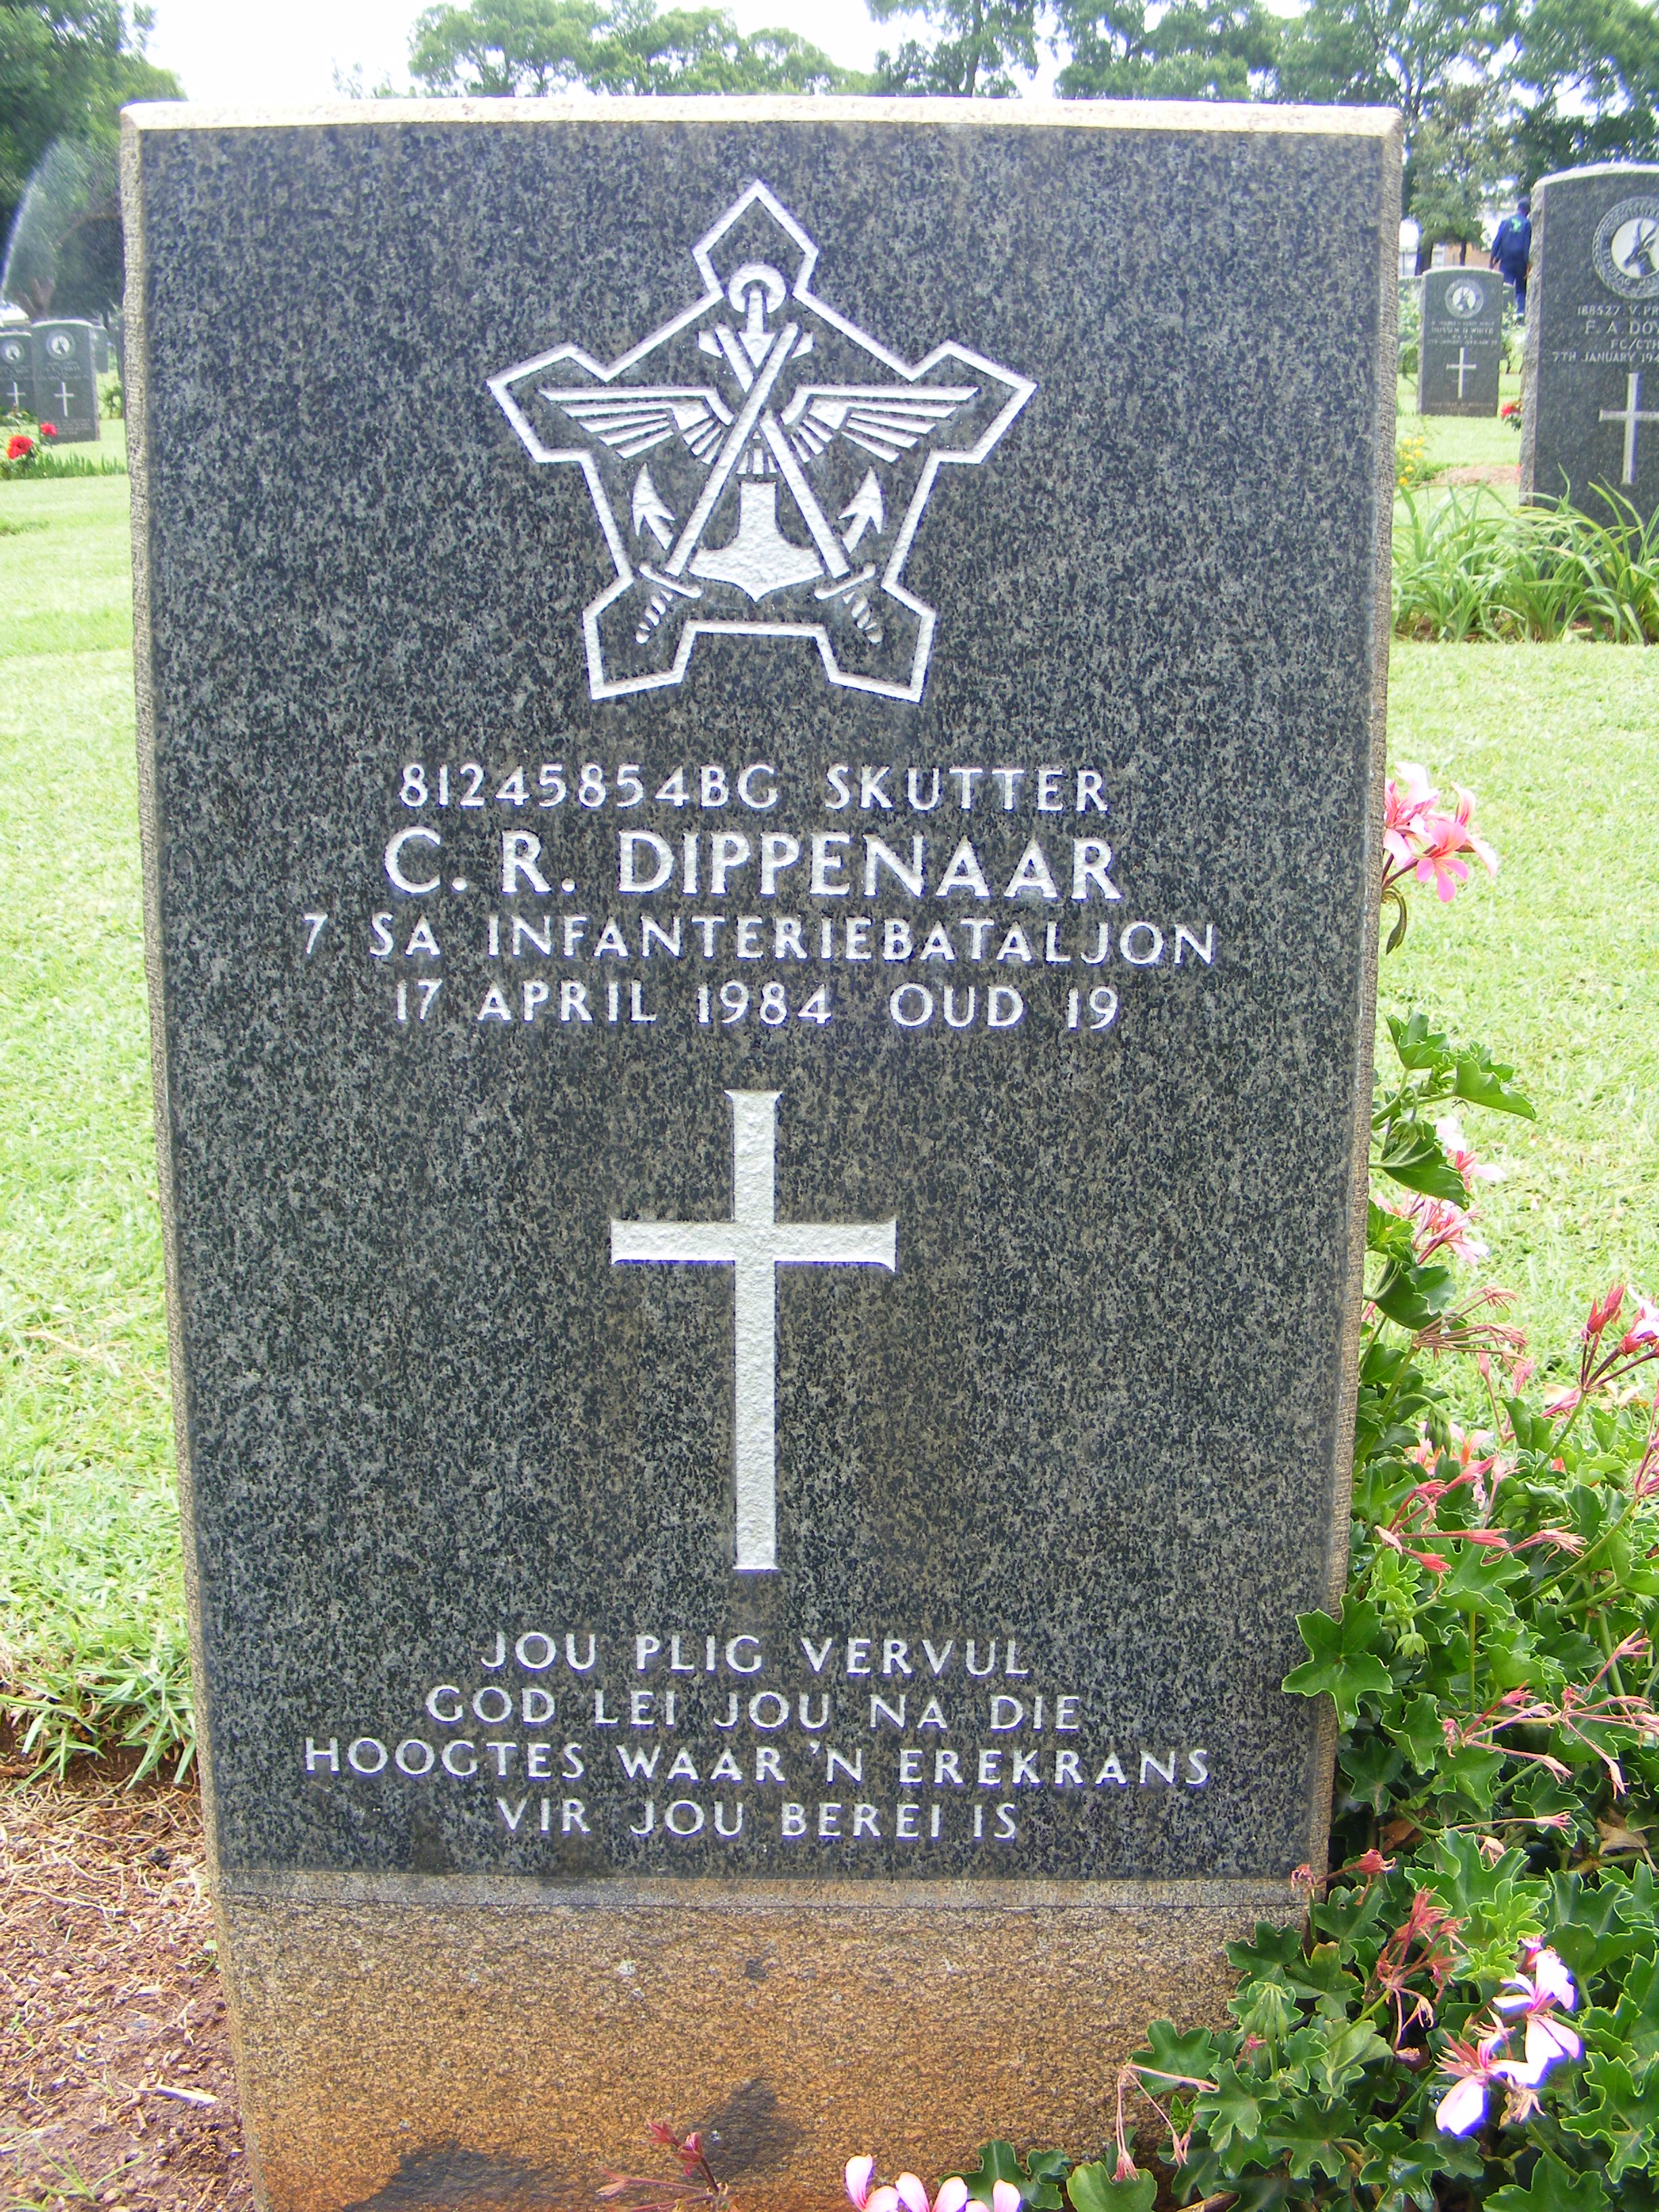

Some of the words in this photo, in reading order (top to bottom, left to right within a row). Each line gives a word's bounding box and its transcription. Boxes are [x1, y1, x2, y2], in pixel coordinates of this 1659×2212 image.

[1552, 351, 1576, 362] 7TH
[1581, 351, 1636, 362] JANUARY
[398, 762, 779, 809] 81245854BG
[823, 762, 1109, 813] SKUTTER
[384, 825, 468, 895] C.
[501, 830, 575, 894] R.
[617, 830, 1122, 900] DIPPENAAR
[303, 911, 329, 955] 7
[369, 912, 441, 957] SA
[488, 914, 1214, 965] INFANTERIEBATALJON
[396, 977, 443, 1021] 17
[476, 979, 657, 1022] APRIL
[697, 979, 832, 1026] 1984
[889, 982, 1024, 1028] OUD
[1067, 985, 1119, 1030] 19
[480, 1631, 596, 1671] JOU
[635, 1634, 762, 1673] PLIG
[800, 1637, 1029, 1676] VERVUL
[424, 1684, 555, 1723] GOD
[594, 1689, 675, 1726] LEI
[712, 1690, 830, 1729] JOU
[869, 1694, 948, 1729] NA
[989, 1694, 1080, 1730] DIE
[304, 1737, 585, 1779] HOOGTES
[615, 1744, 786, 1782] WAAR
[808, 1740, 863, 1782] 'N
[899, 1748, 1208, 1786] EREKRANS
[496, 1797, 591, 1833] VIR
[630, 1799, 744, 1837] JOU
[781, 1802, 941, 1839] BEREI
[972, 1802, 1017, 1839] IS
